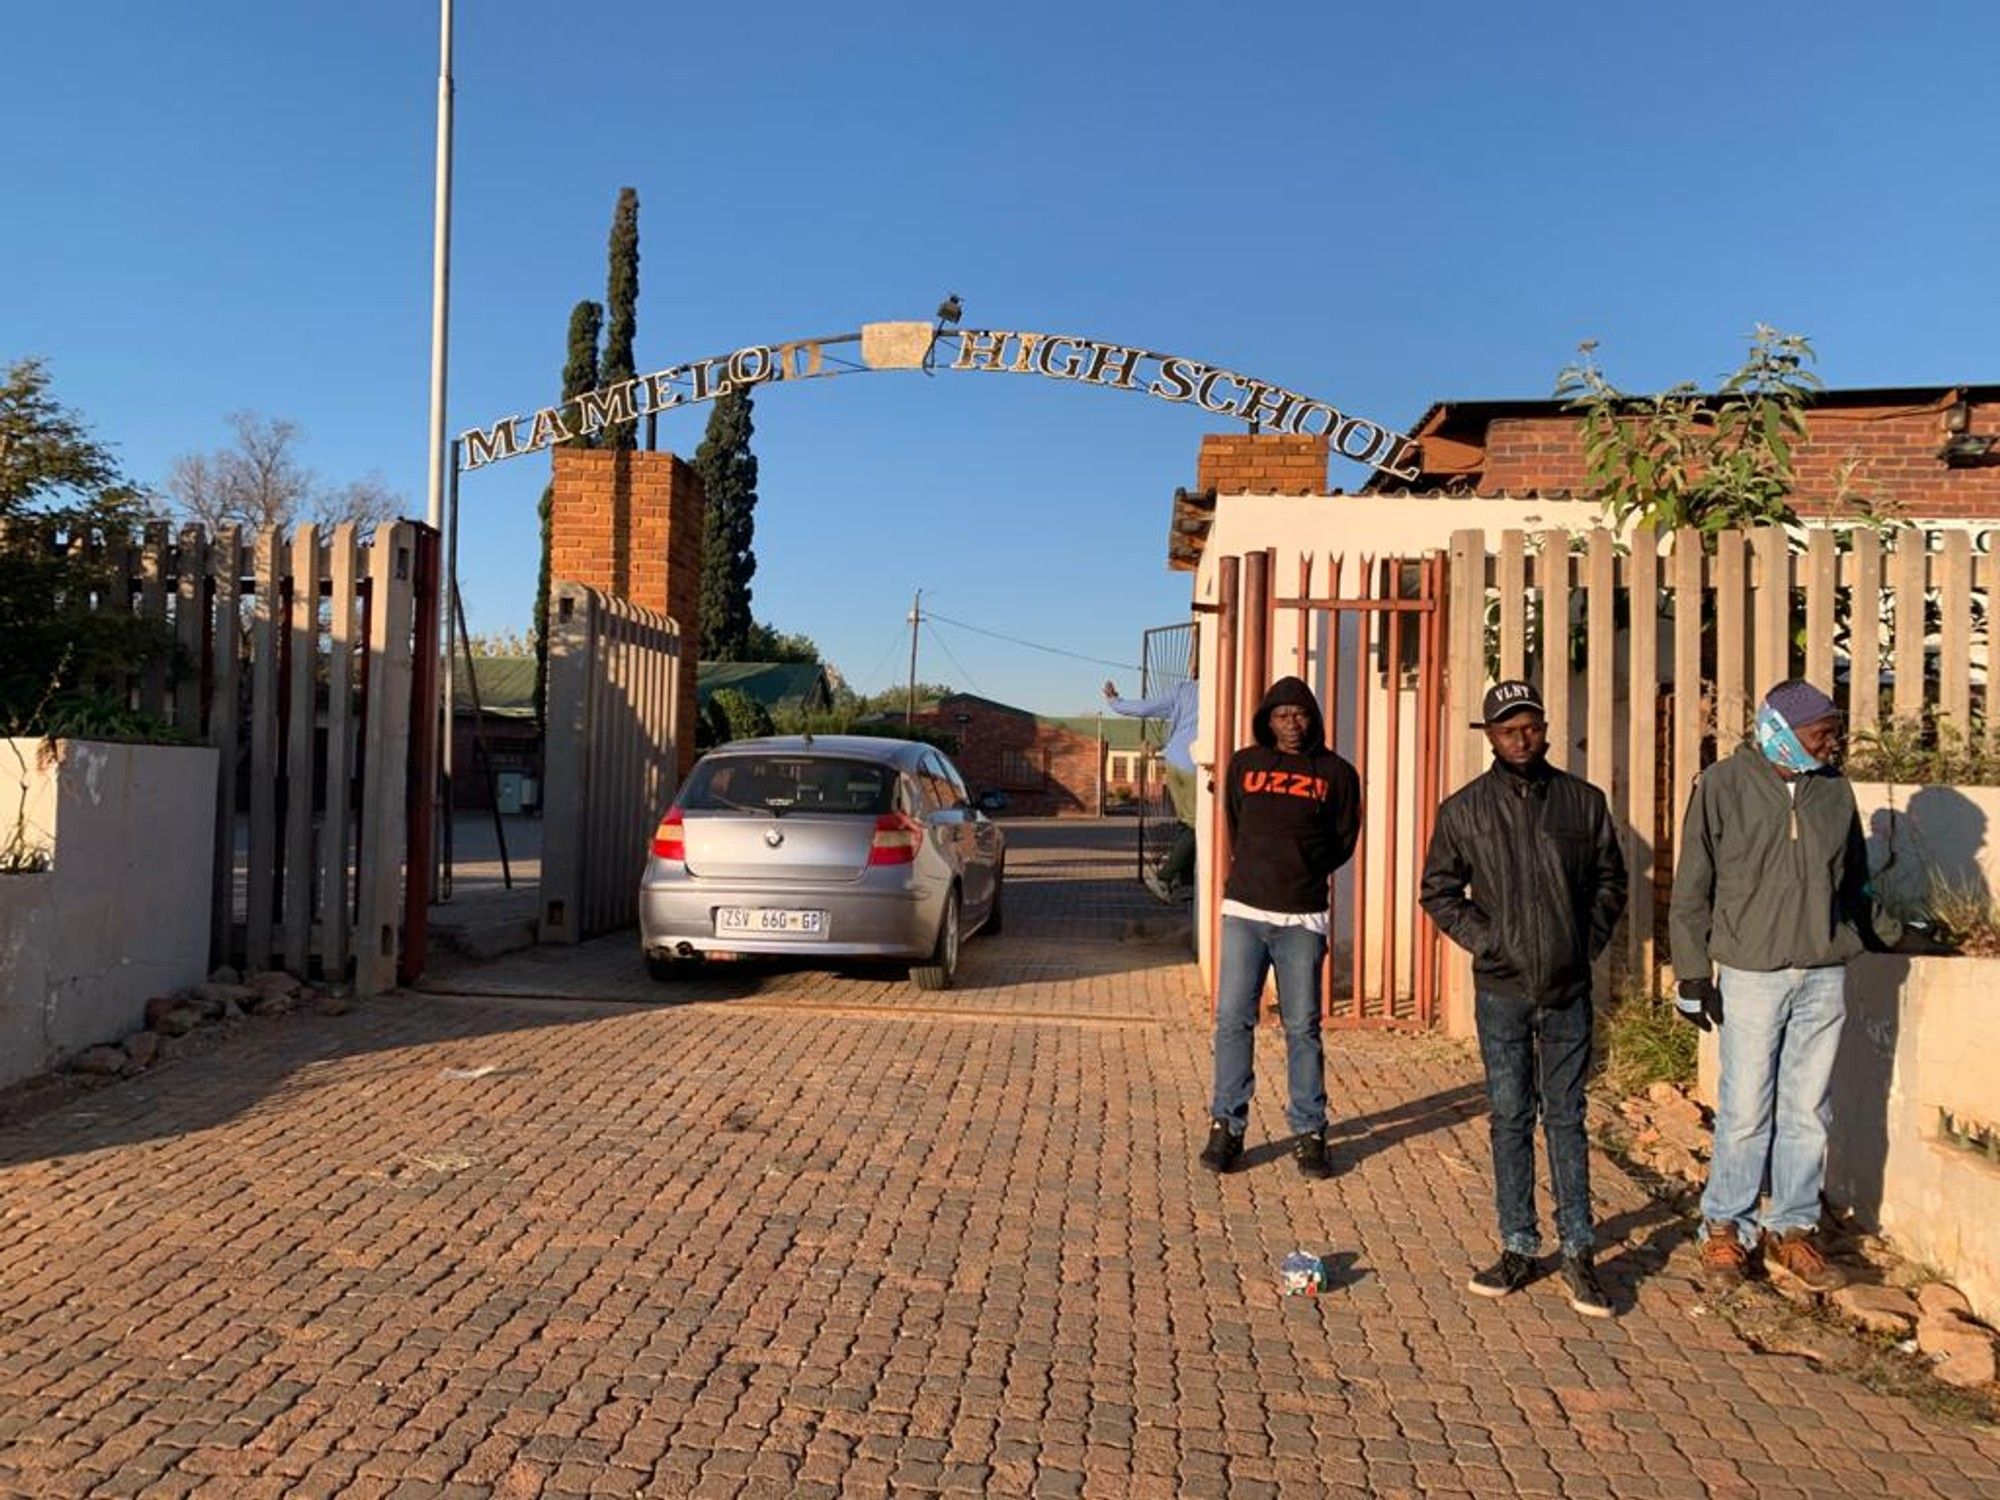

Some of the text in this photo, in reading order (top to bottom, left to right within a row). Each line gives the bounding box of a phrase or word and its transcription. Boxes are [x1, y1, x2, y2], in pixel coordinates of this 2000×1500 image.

[951, 330, 1147, 389] HIGH
[1150, 357, 1421, 481] SCHOOL
[725, 909, 750, 927] ZSV
[801, 913, 820, 930] GP
